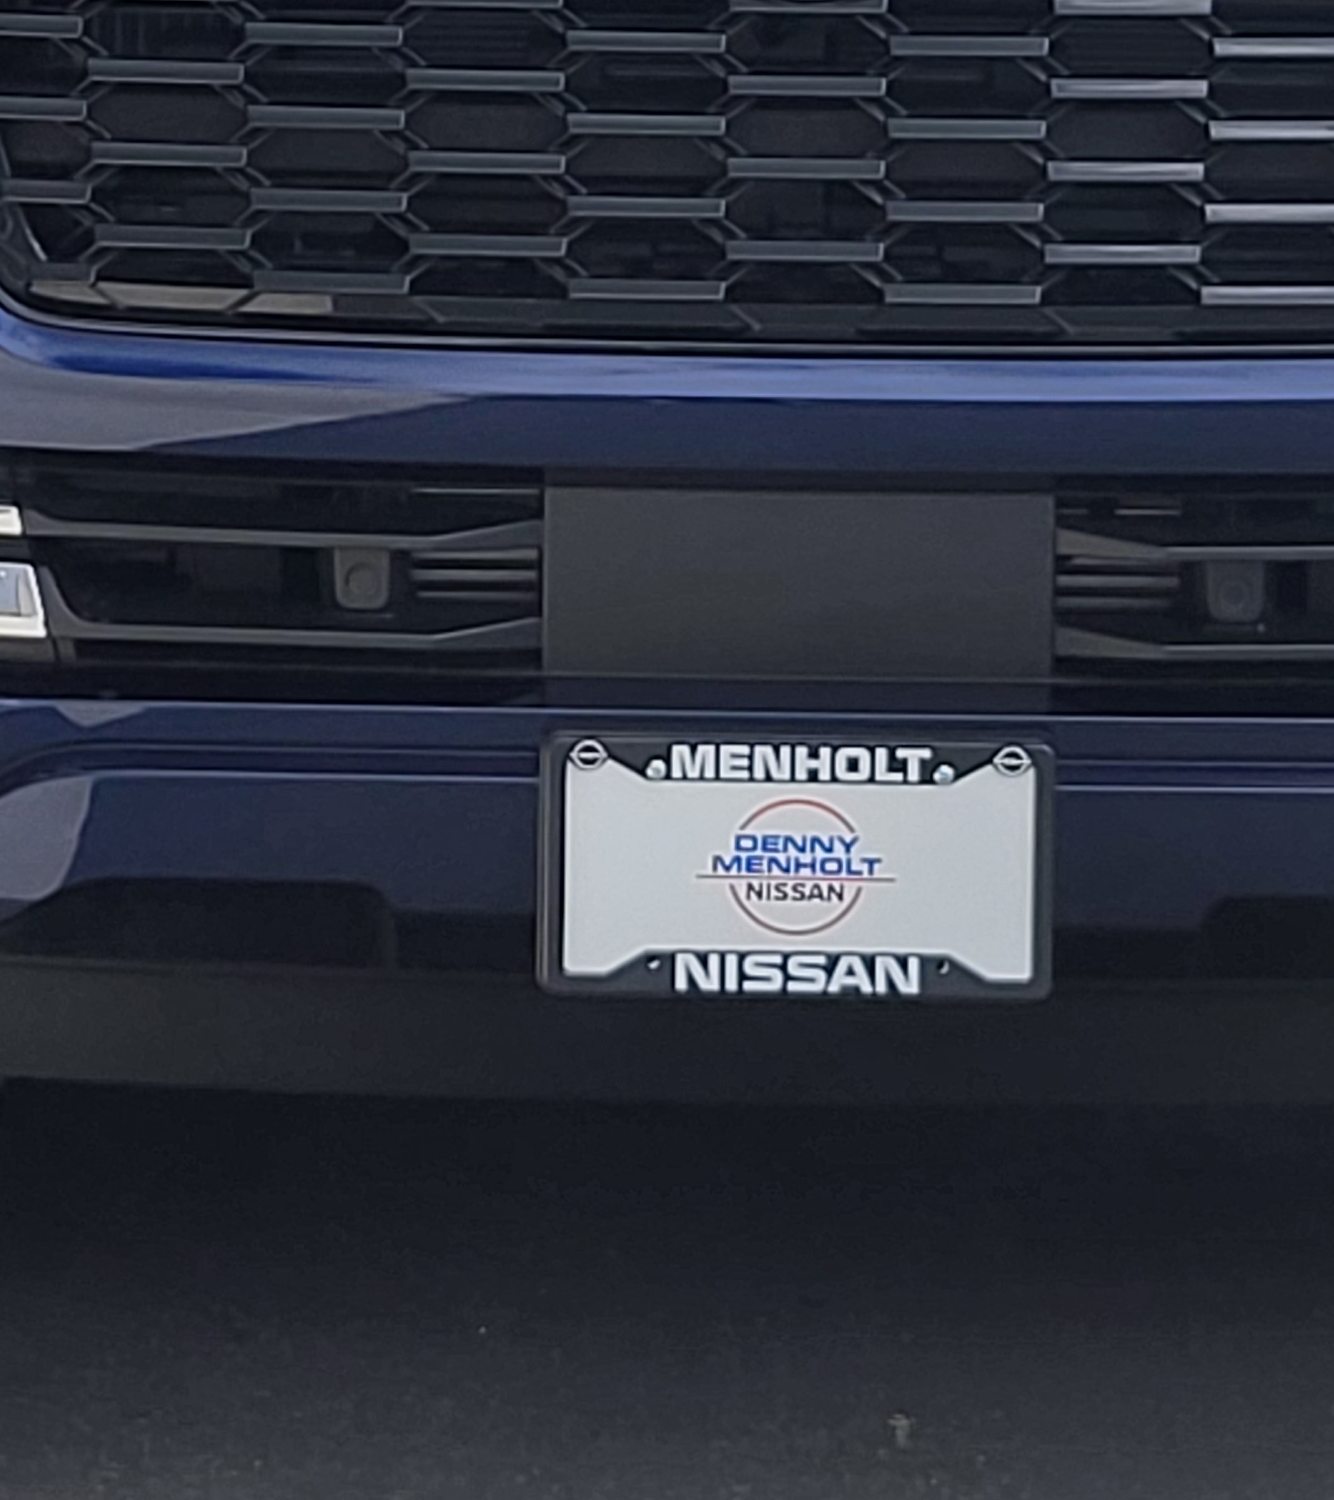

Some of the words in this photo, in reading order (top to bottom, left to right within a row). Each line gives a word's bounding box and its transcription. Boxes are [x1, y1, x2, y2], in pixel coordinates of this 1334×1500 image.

[670, 744, 934, 783] MENHOLT
[733, 835, 860, 855] DENNY
[712, 855, 883, 877] MENHOLT
[745, 882, 845, 903] NISSAN
[674, 953, 920, 994] NISSAN
